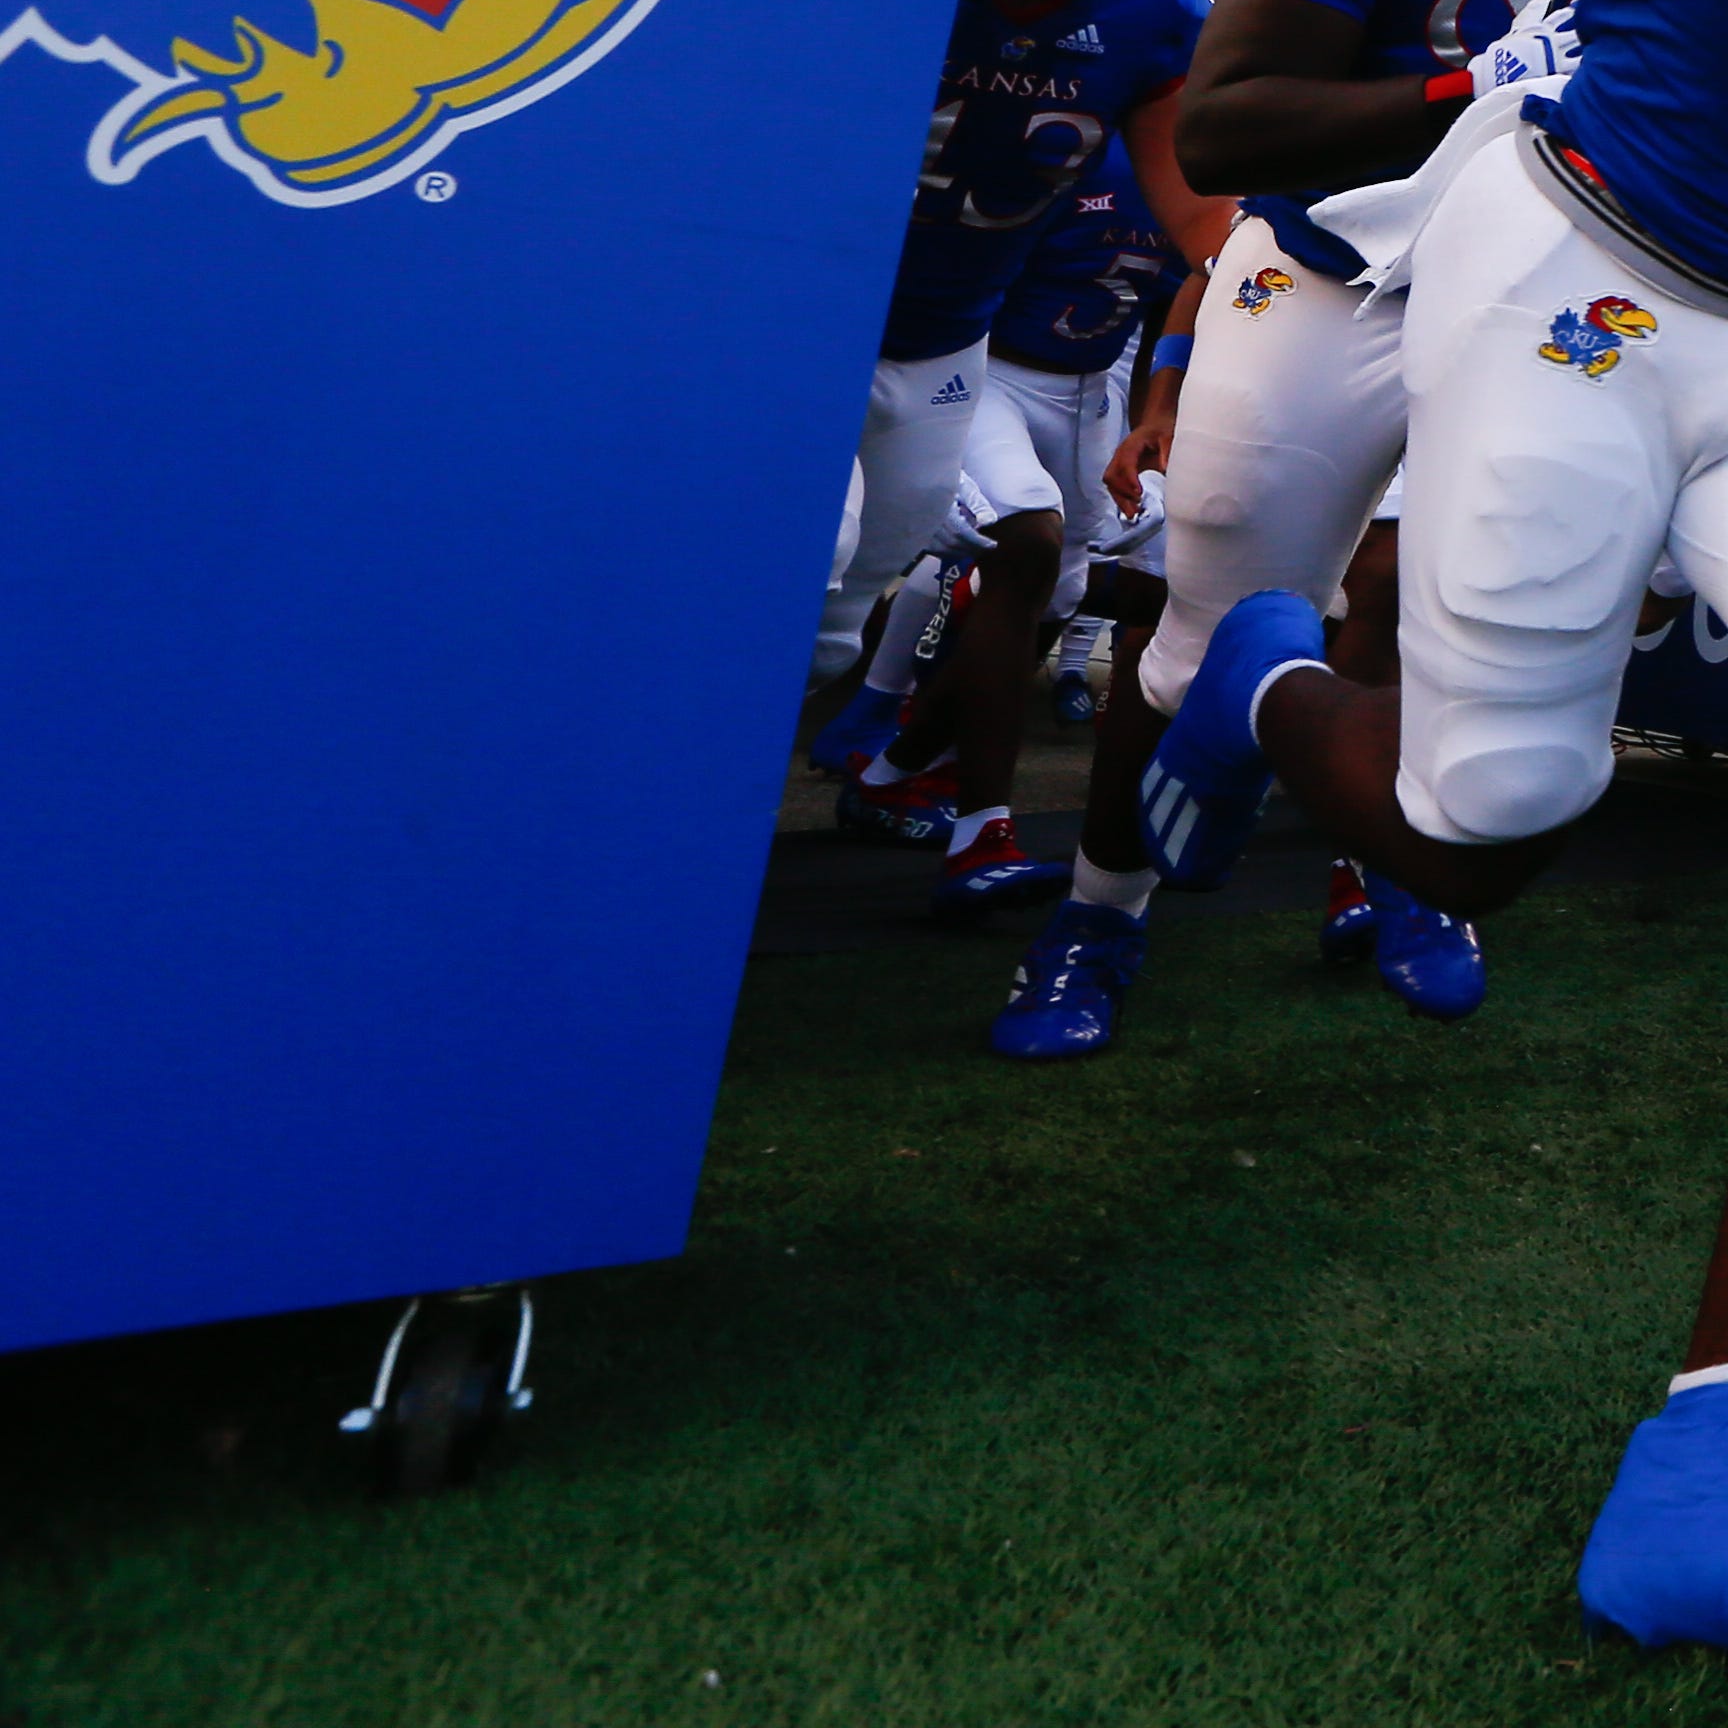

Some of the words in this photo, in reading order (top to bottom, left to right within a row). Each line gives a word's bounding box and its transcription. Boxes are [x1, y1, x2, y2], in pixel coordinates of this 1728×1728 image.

[1056, 37, 1104, 54] adidas
[940, 60, 1083, 102] ANSAS
[1103, 228, 1173, 249] KAN
[1053, 252, 1166, 339] 5
[1571, 328, 1598, 350] KU
[930, 390, 971, 406] adidas
